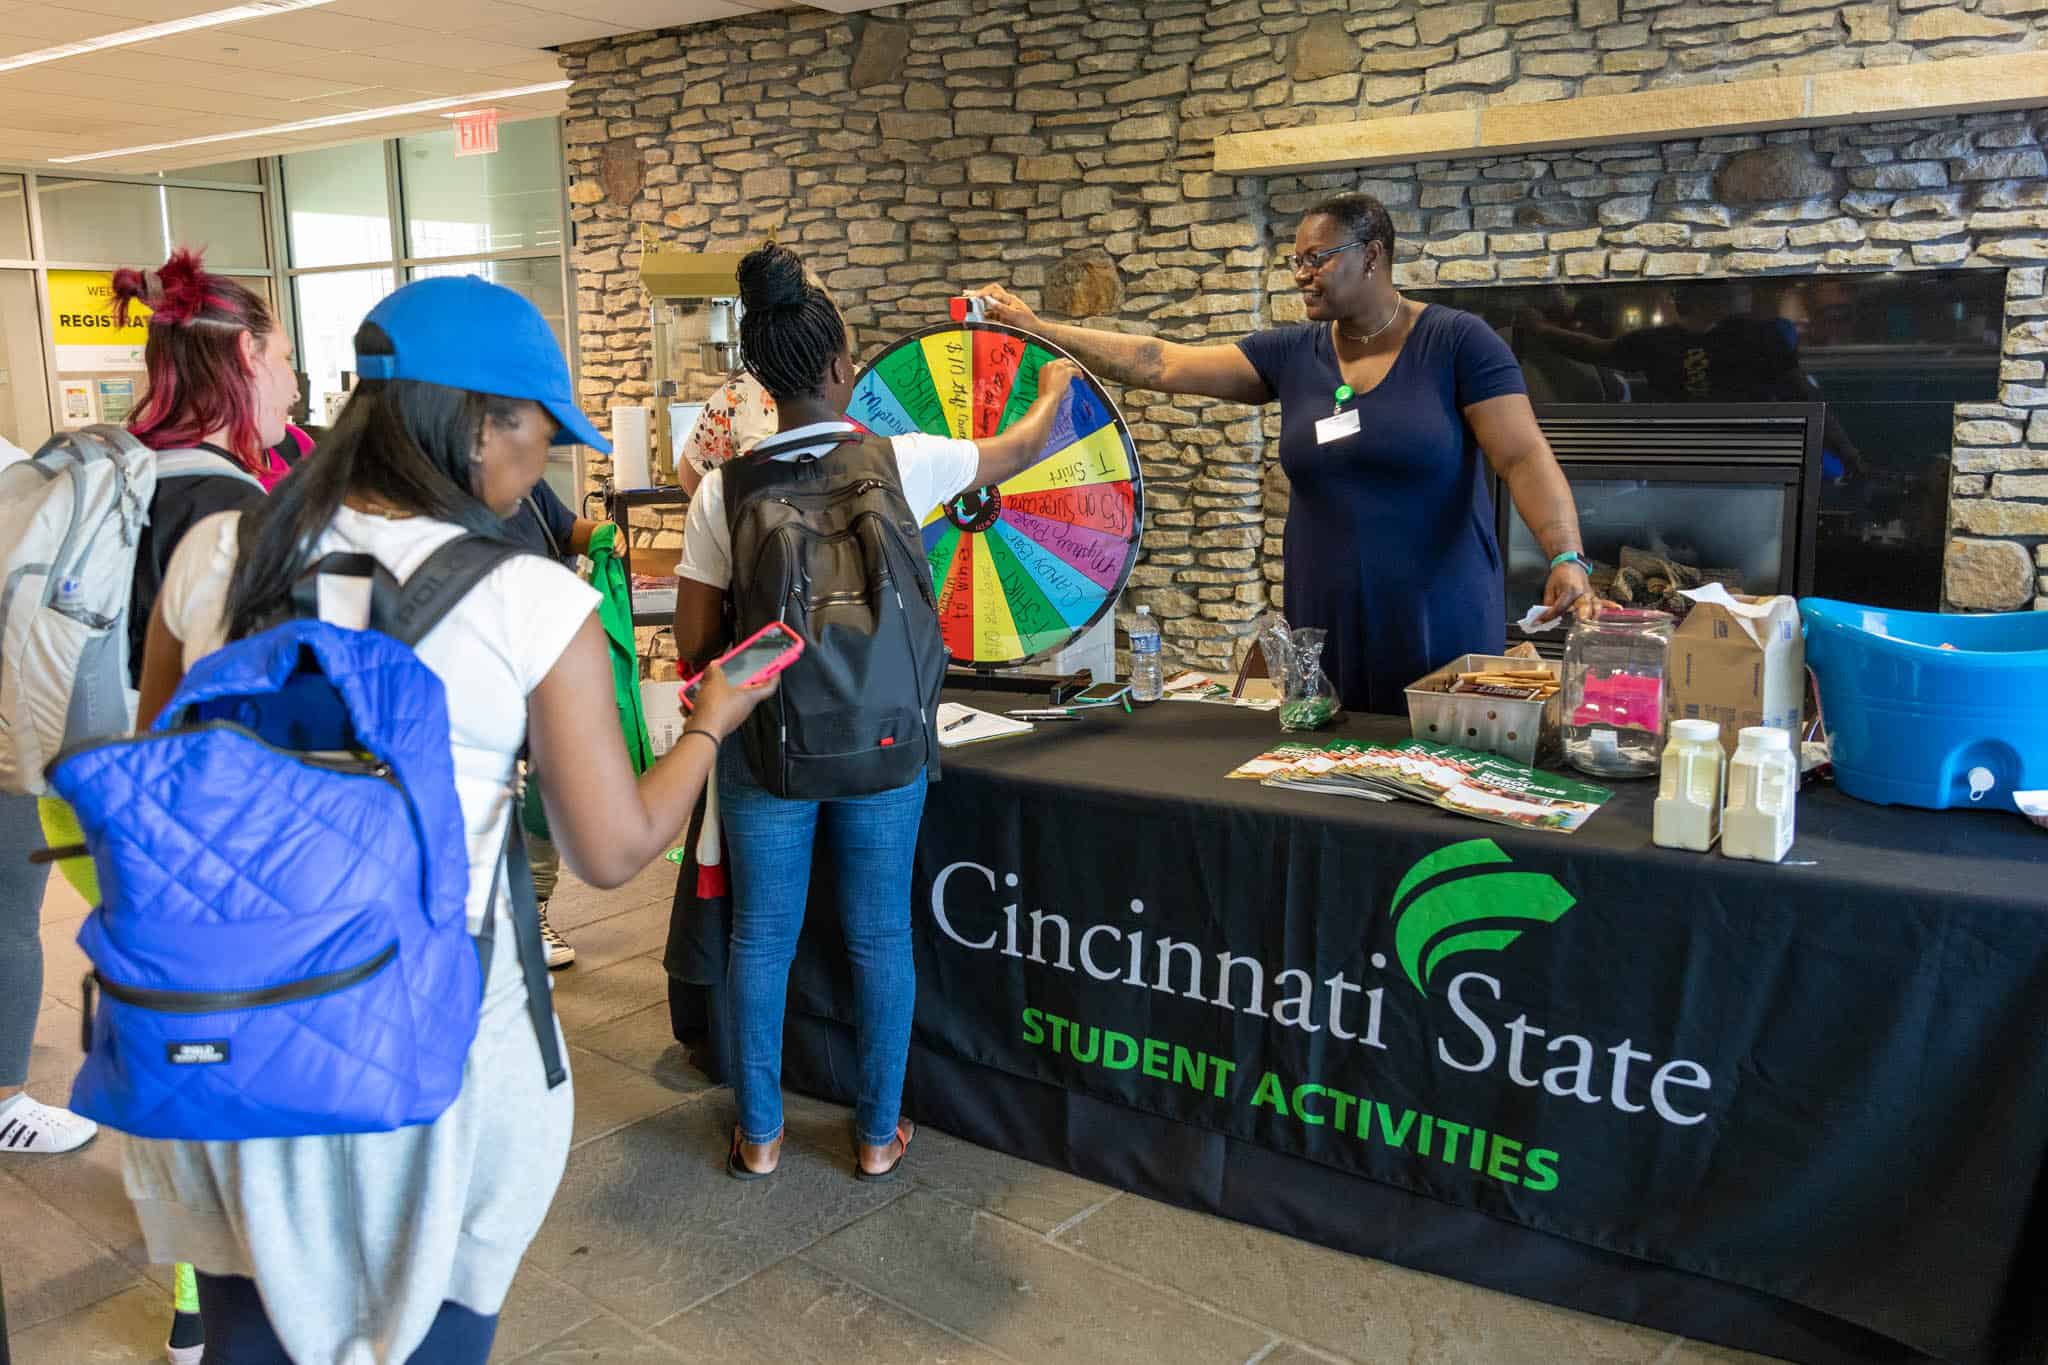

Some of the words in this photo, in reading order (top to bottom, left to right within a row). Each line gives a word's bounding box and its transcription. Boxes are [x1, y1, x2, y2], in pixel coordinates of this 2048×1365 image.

[460, 114, 496, 150] EXIT
[60, 313, 149, 328] REGISA
[931, 860, 1388, 1050] Cincinnati
[1437, 970, 1713, 1127] State
[1021, 1006, 1236, 1098] STUDENT
[1250, 1071, 1561, 1192] ACTIVITIES
